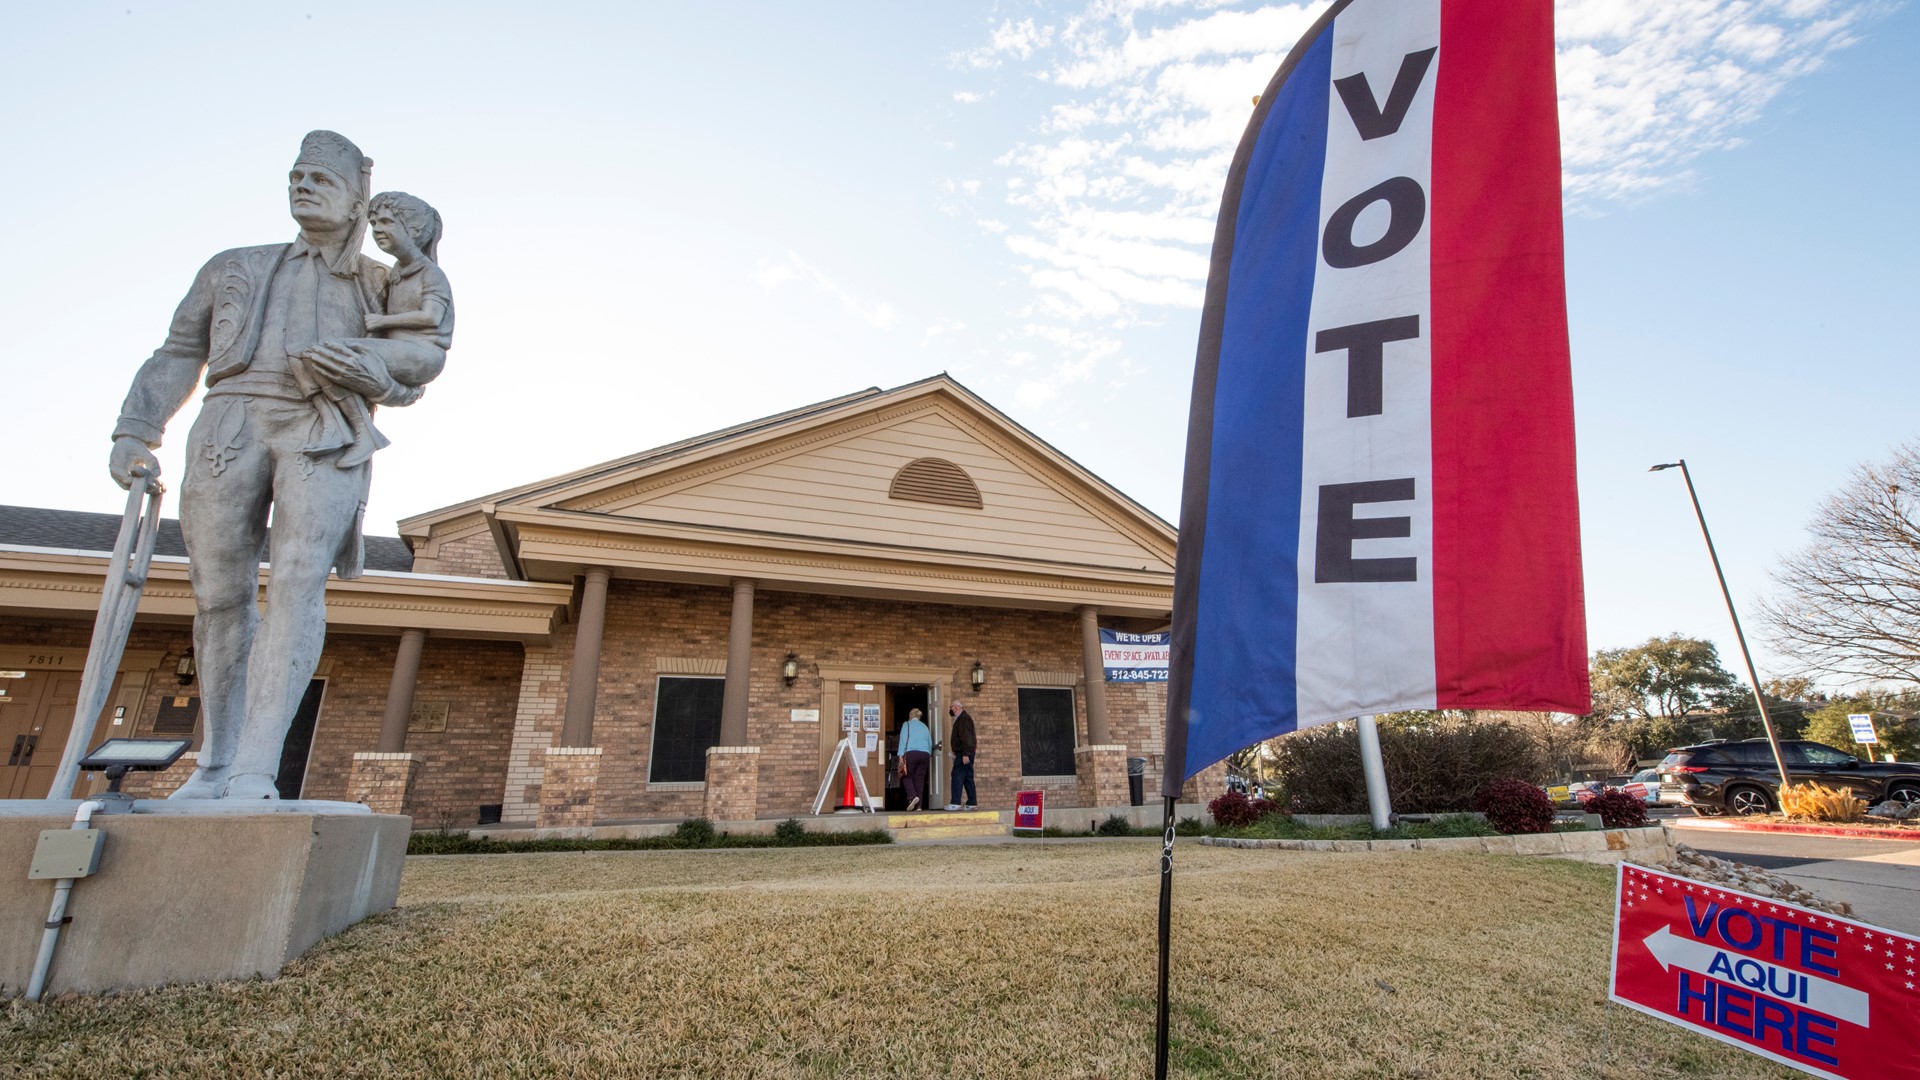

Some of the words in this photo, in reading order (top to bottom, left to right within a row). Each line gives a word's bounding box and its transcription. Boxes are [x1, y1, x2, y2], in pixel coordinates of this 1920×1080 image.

[1314, 46, 1438, 584] VOTE
[28, 655, 63, 665] 7811
[1104, 650, 1122, 661] EVENT
[1123, 651, 1142, 661] SPACE
[1115, 632, 1141, 642] WE'RE
[1142, 633, 1162, 643] OPEN
[1683, 895, 1839, 978] VOTE
[1707, 951, 1808, 1004] AQUI
[1678, 971, 1839, 1067] HERE
